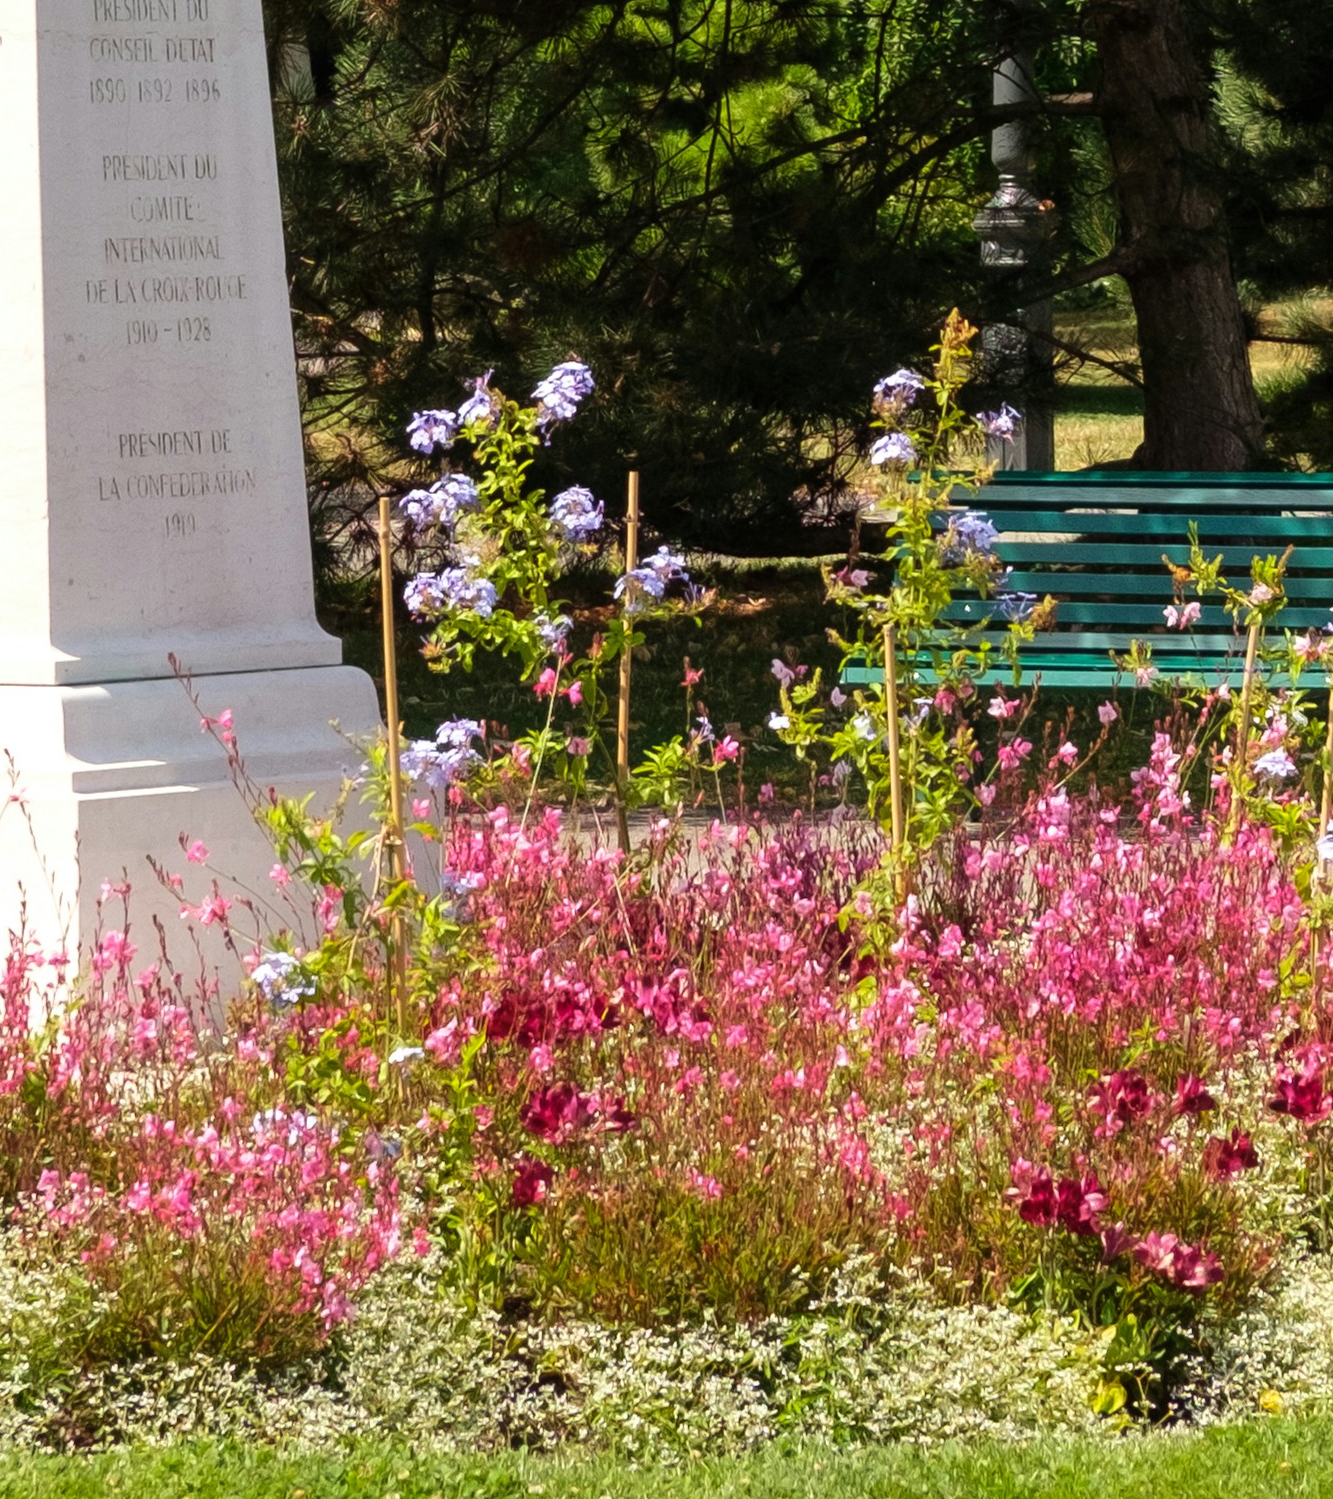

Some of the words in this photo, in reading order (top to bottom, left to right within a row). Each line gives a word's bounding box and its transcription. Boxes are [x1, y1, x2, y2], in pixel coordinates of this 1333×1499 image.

[89, 37, 158, 62] CONSEIL
[90, 78, 126, 103] 1890
[138, 78, 172, 103] 1892
[185, 78, 220, 102] 1896
[195, 153, 217, 180] DU
[104, 235, 225, 263] INTERNATIONAL
[86, 279, 108, 303] DE
[114, 278, 137, 303] LA
[141, 274, 247, 302] CROIX-ROUGE
[211, 429, 232, 454] DE
[98, 476, 121, 501] LA
